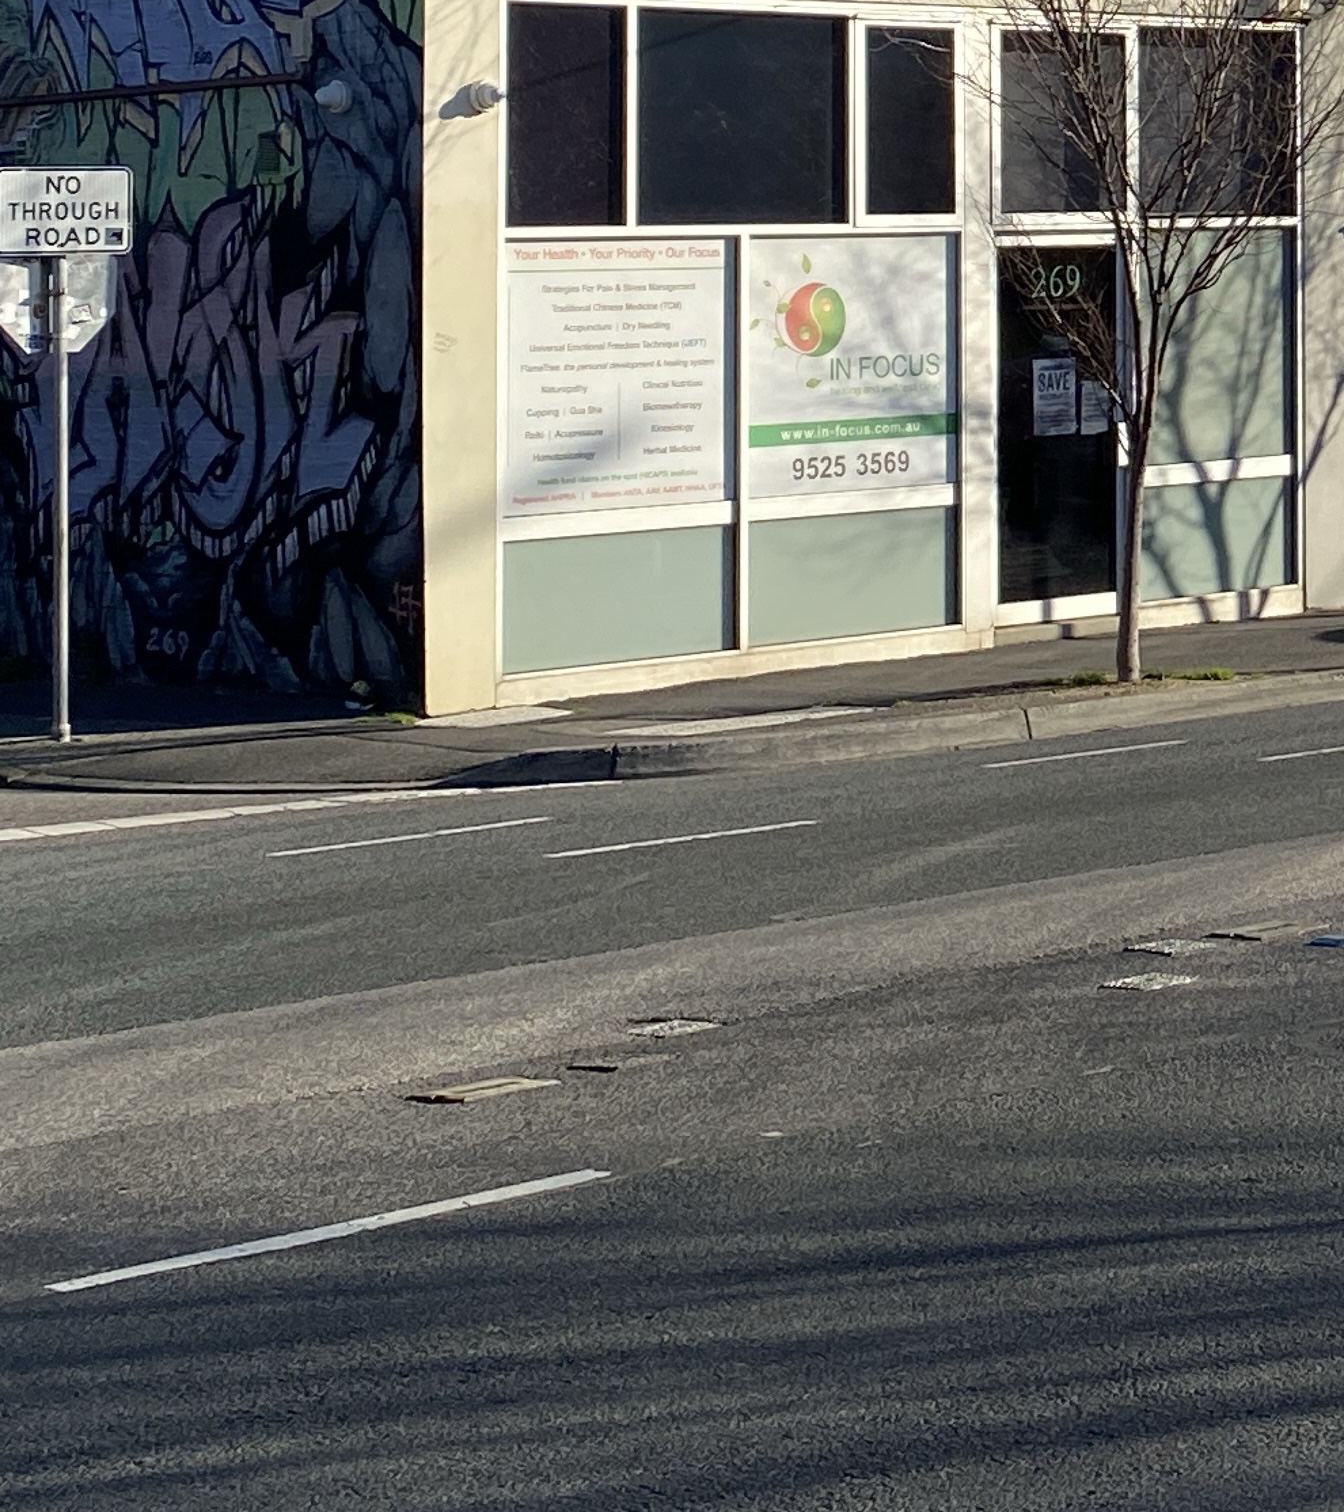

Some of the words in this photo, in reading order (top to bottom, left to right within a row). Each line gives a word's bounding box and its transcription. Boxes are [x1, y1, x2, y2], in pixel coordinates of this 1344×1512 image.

[45, 175, 81, 195] NO
[8, 201, 119, 221] THROUGH
[25, 227, 101, 247] ROAD
[514, 249, 539, 260] Your
[543, 249, 578, 259] Health
[589, 248, 614, 259] Your
[617, 248, 655, 260] Priority
[665, 247, 685, 258] Our
[688, 247, 720, 258] Focus
[1031, 265, 1080, 298] 269
[623, 322, 636, 331] Dry
[830, 357, 850, 380] IN
[859, 353, 940, 378] FOCUS
[1038, 371, 1071, 392] SAVE
[780, 420, 921, 441] www.in-focus.com.au
[793, 455, 846, 481] 9525
[856, 449, 910, 476] 3569
[146, 627, 190, 661] 269
